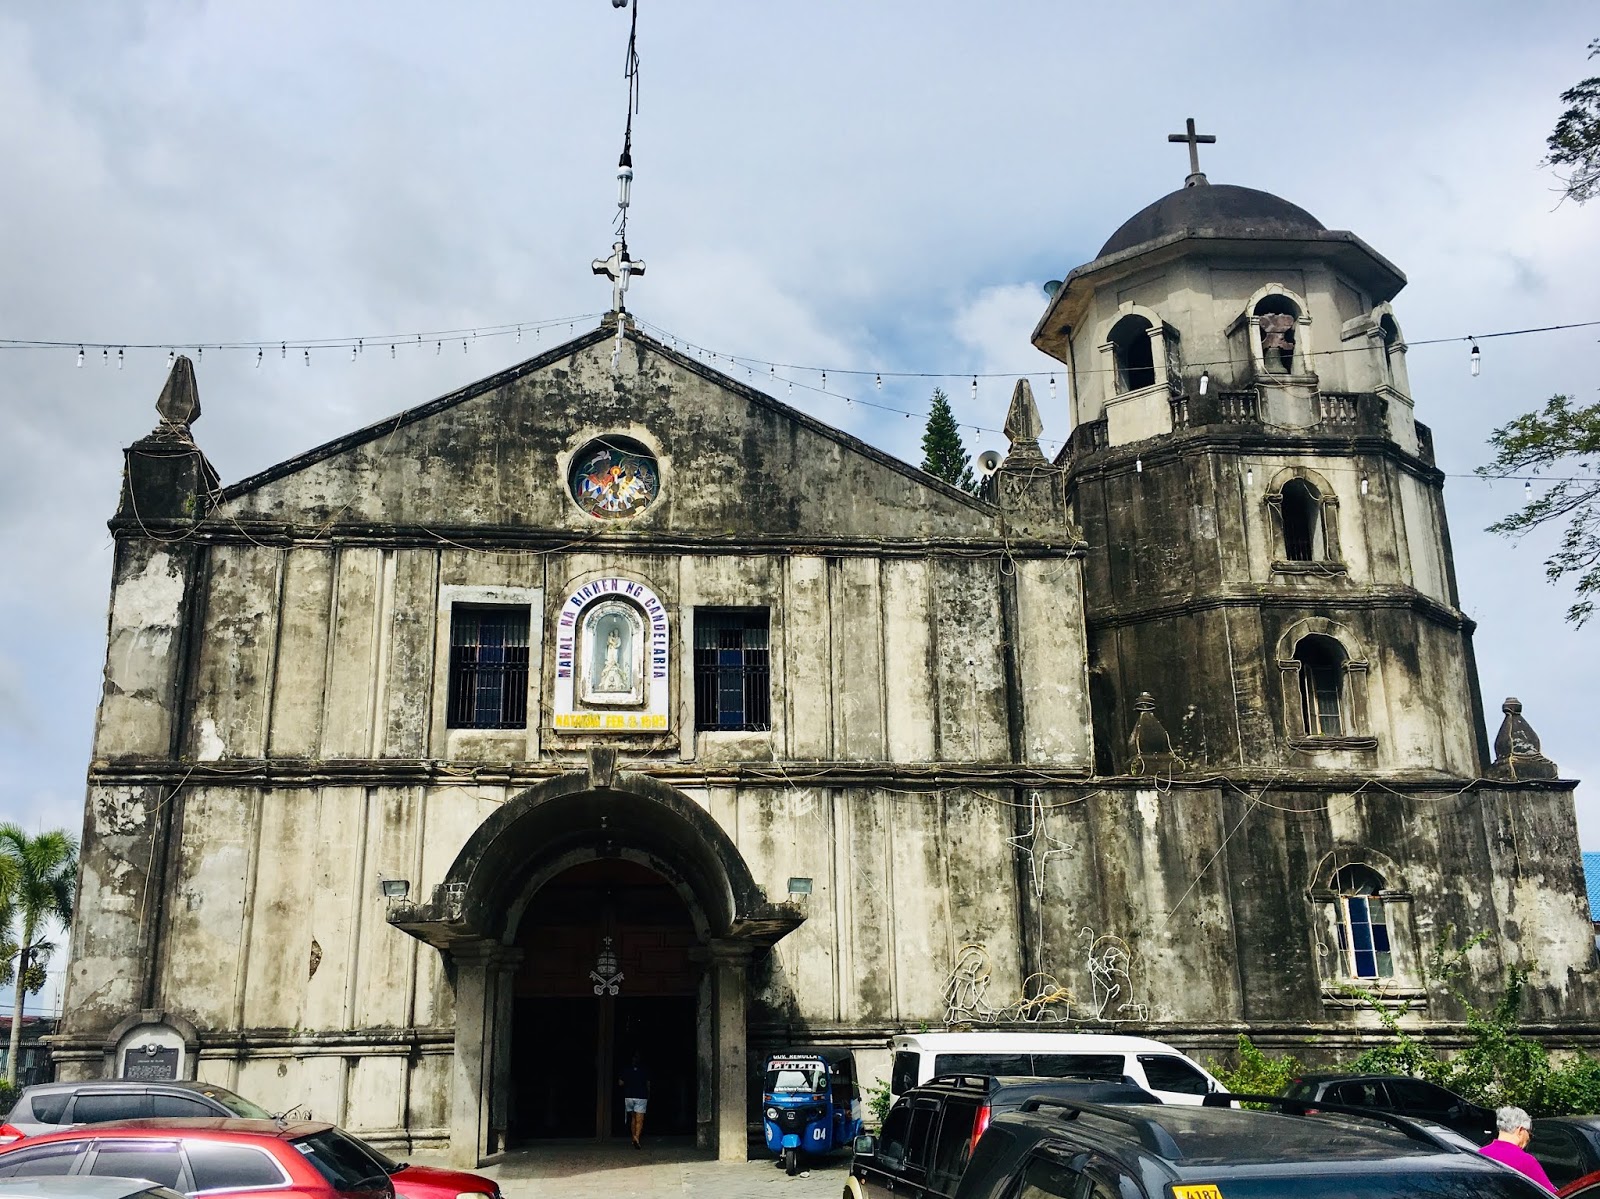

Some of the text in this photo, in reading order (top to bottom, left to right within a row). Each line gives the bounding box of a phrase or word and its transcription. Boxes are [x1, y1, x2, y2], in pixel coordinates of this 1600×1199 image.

[558, 578, 666, 679] MAHAL NA BIRHEN NG CANDELARIA
[813, 1128, 826, 1140] 04
